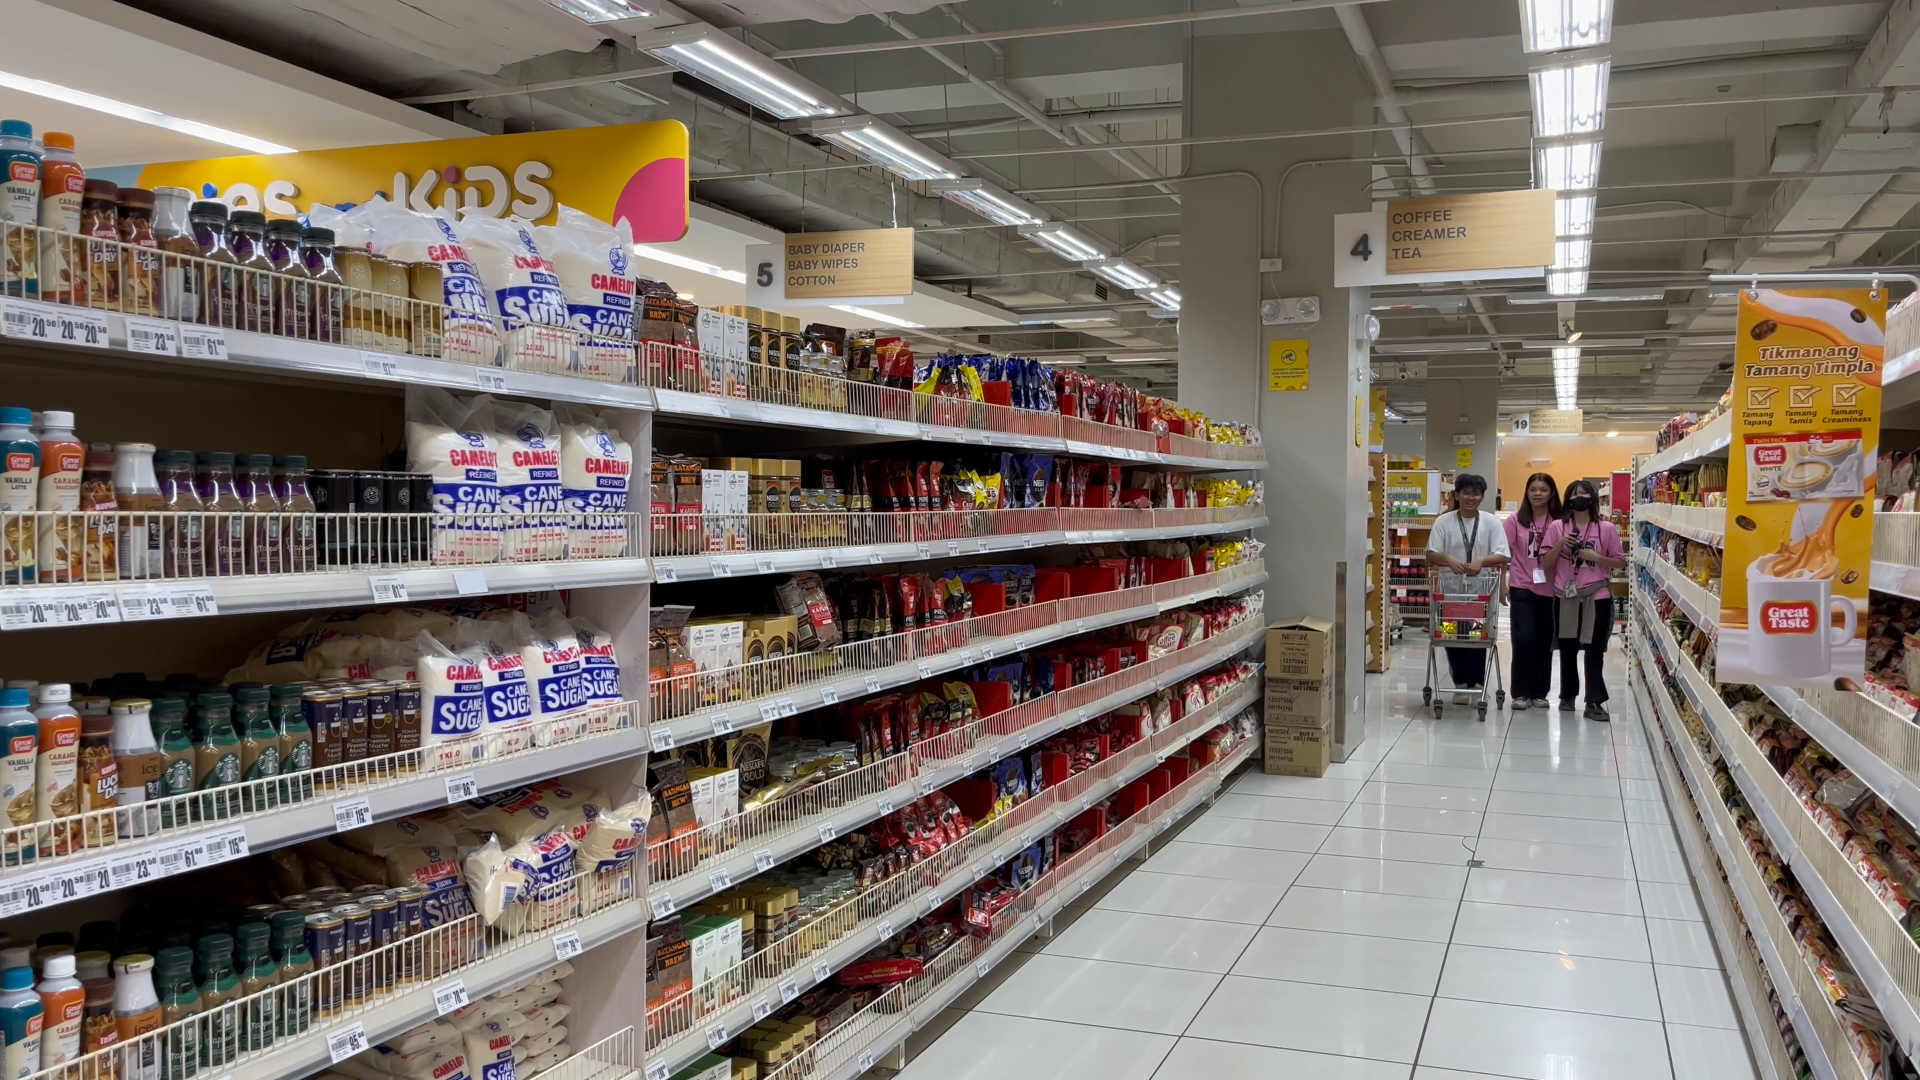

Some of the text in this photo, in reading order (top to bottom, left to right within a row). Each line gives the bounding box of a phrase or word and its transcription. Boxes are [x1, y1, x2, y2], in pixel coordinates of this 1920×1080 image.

[6, 186, 36, 197] VANILLA
[1392, 210, 1452, 224] COFFEE
[1392, 226, 1467, 242] CREAMER
[788, 242, 865, 255] BABY DIAPER
[1351, 233, 1372, 261] 4
[1392, 247, 1422, 260] TEA
[788, 258, 858, 270] BABY WIPES
[757, 263, 773, 287] 5
[788, 275, 836, 286] COTTON
[591, 273, 635, 295] CAMELOT
[1760, 345, 1859, 361] Tikman ang
[1745, 360, 1875, 379] Tamang Timpla
[1742, 411, 1774, 419] Tamang
[1785, 410, 1817, 418] Tamang
[1831, 409, 1863, 417] Tamang
[1514, 420, 1528, 429] 19
[1743, 419, 1773, 427] Tapang
[1822, 415, 1872, 423] Creaminess
[512, 450, 560, 467] CAMELOT
[1758, 449, 1782, 457] Great
[1758, 454, 1783, 462] Taste
[11, 456, 31, 464] Great
[62, 456, 80, 465] Great
[11, 462, 30, 470] Taste
[62, 462, 80, 470] Taste
[585, 458, 629, 475] CAMELOT
[533, 470, 558, 479] REFINED
[600, 478, 625, 487] REFINED
[525, 486, 563, 500] CANE
[589, 493, 627, 507] CANE
[1768, 606, 1810, 620] Great
[1768, 617, 1810, 629] Taste
[593, 669, 617, 681] CANE
[673, 665, 694, 674] SPECIAL
[56, 731, 76, 740] Great
[57, 736, 76, 745] Taste
[14, 738, 33, 746] Great
[14, 743, 33, 751] Taste
[7, 758, 34, 766] VANILLA
[743, 769, 765, 782] GOLD
[439, 888, 468, 905] CANE
[664, 954, 685, 967] BREW
